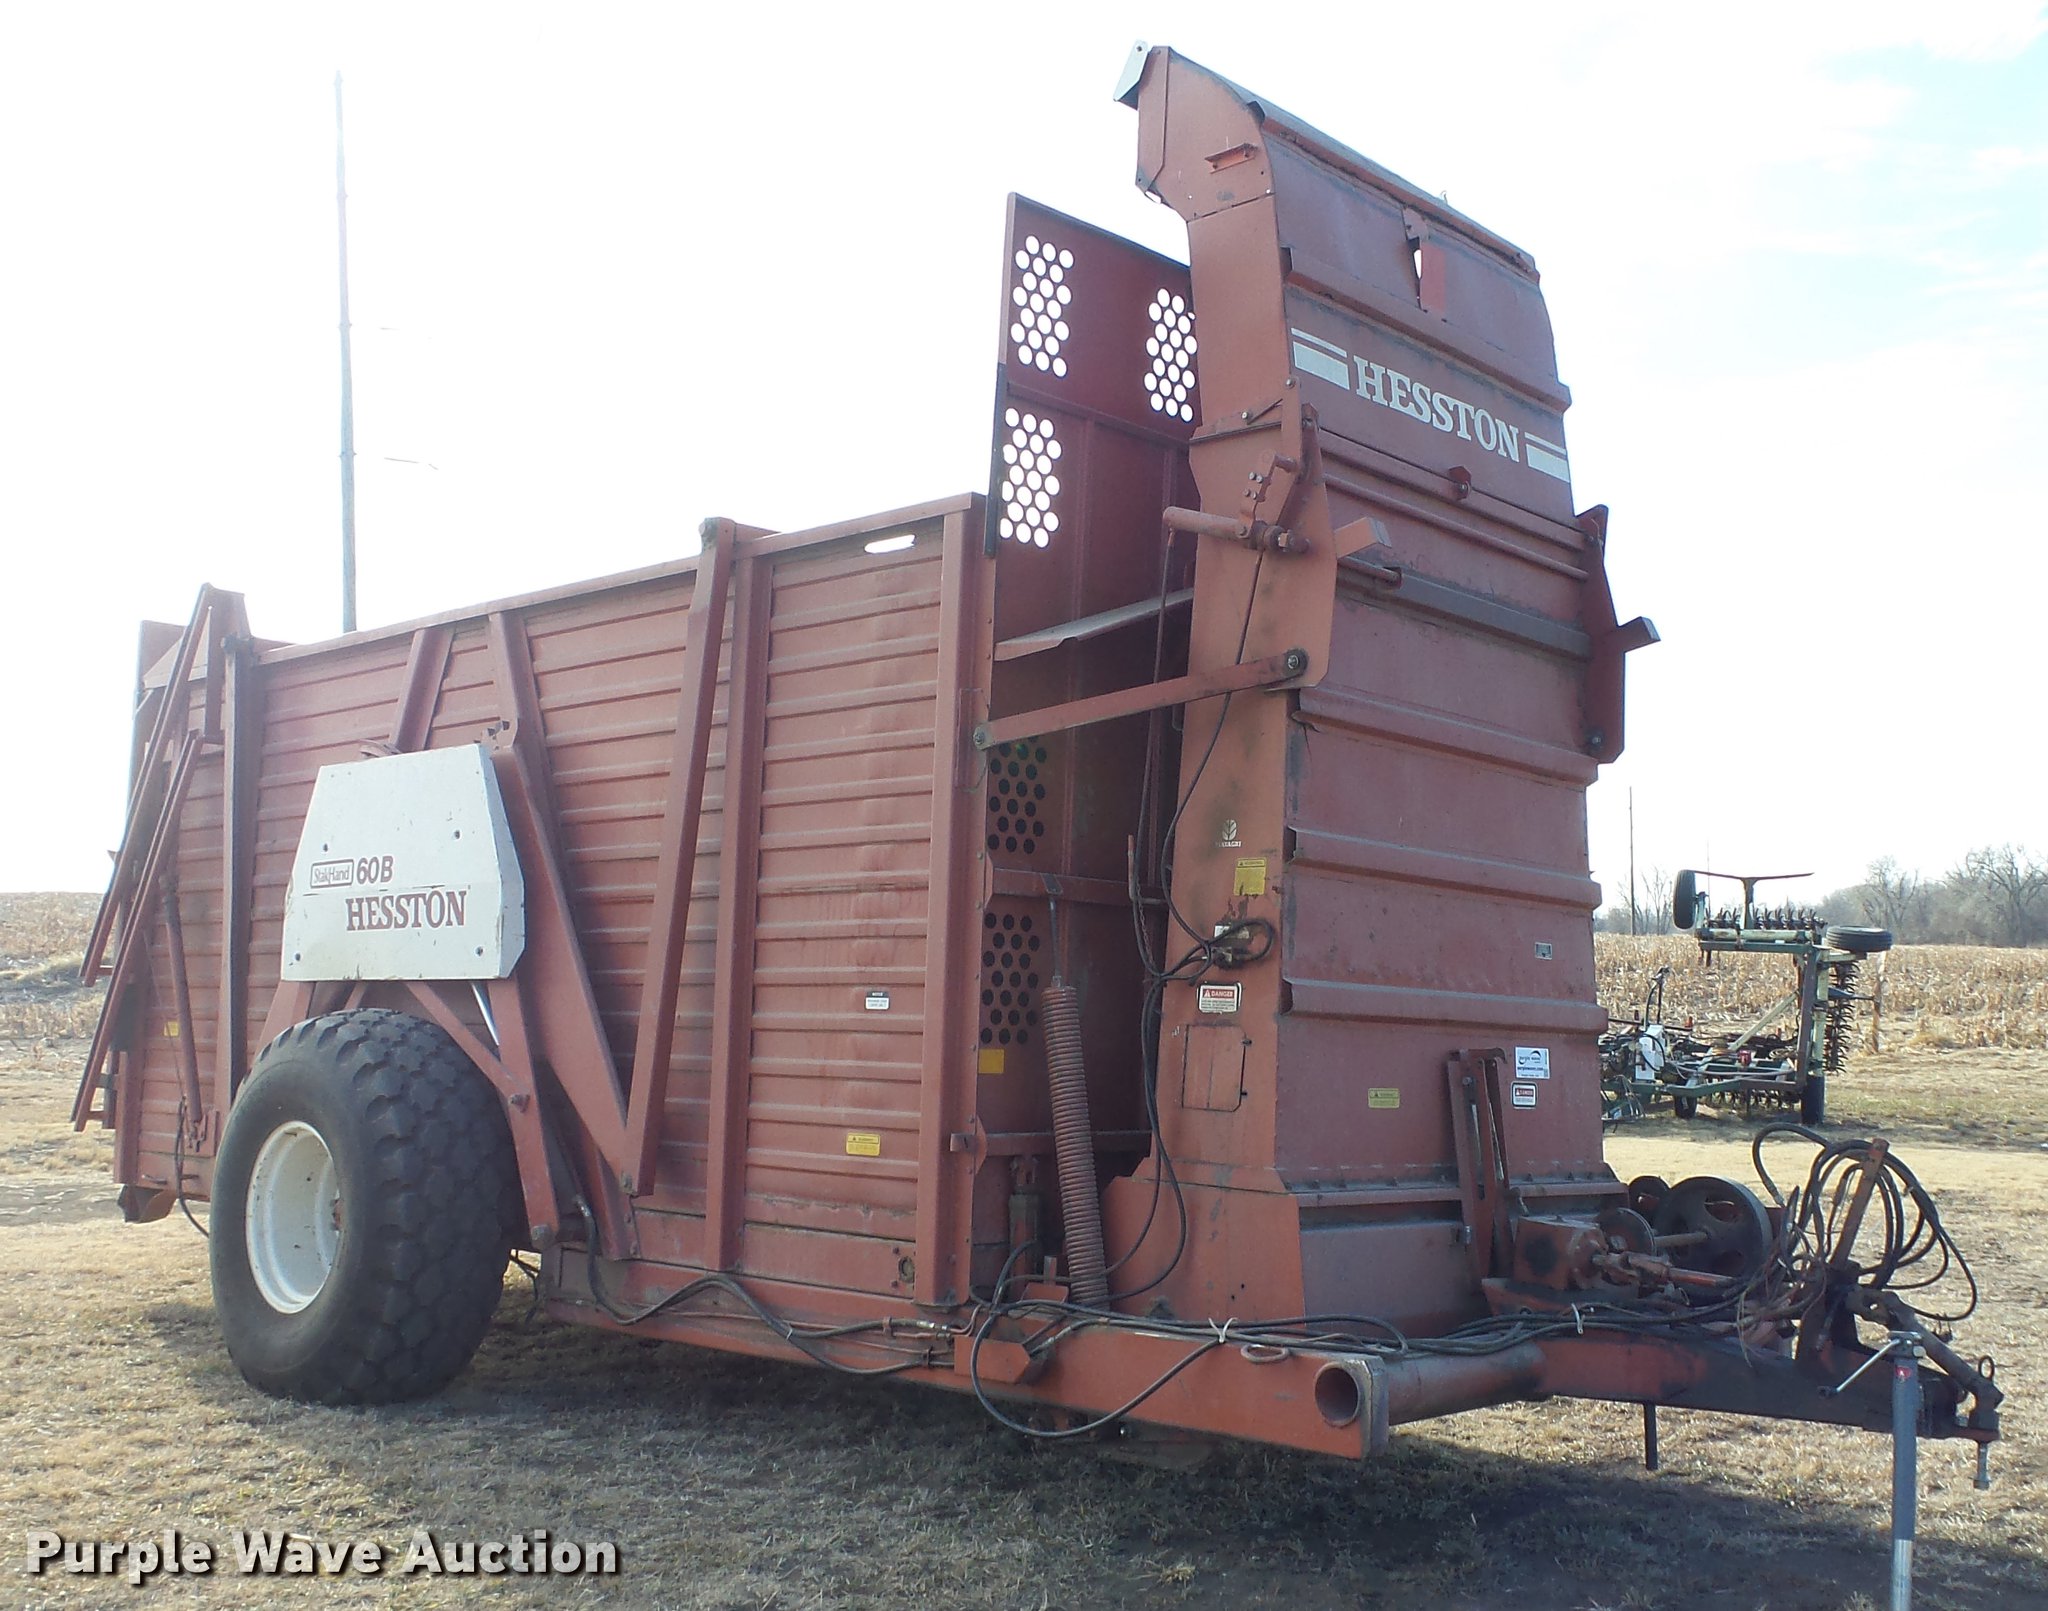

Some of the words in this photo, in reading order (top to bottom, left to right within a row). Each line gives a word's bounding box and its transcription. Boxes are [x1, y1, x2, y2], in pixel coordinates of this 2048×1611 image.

[1353, 355, 1520, 463] HESSTON
[356, 855, 394, 885] 60B
[345, 890, 467, 931] HESSTON
